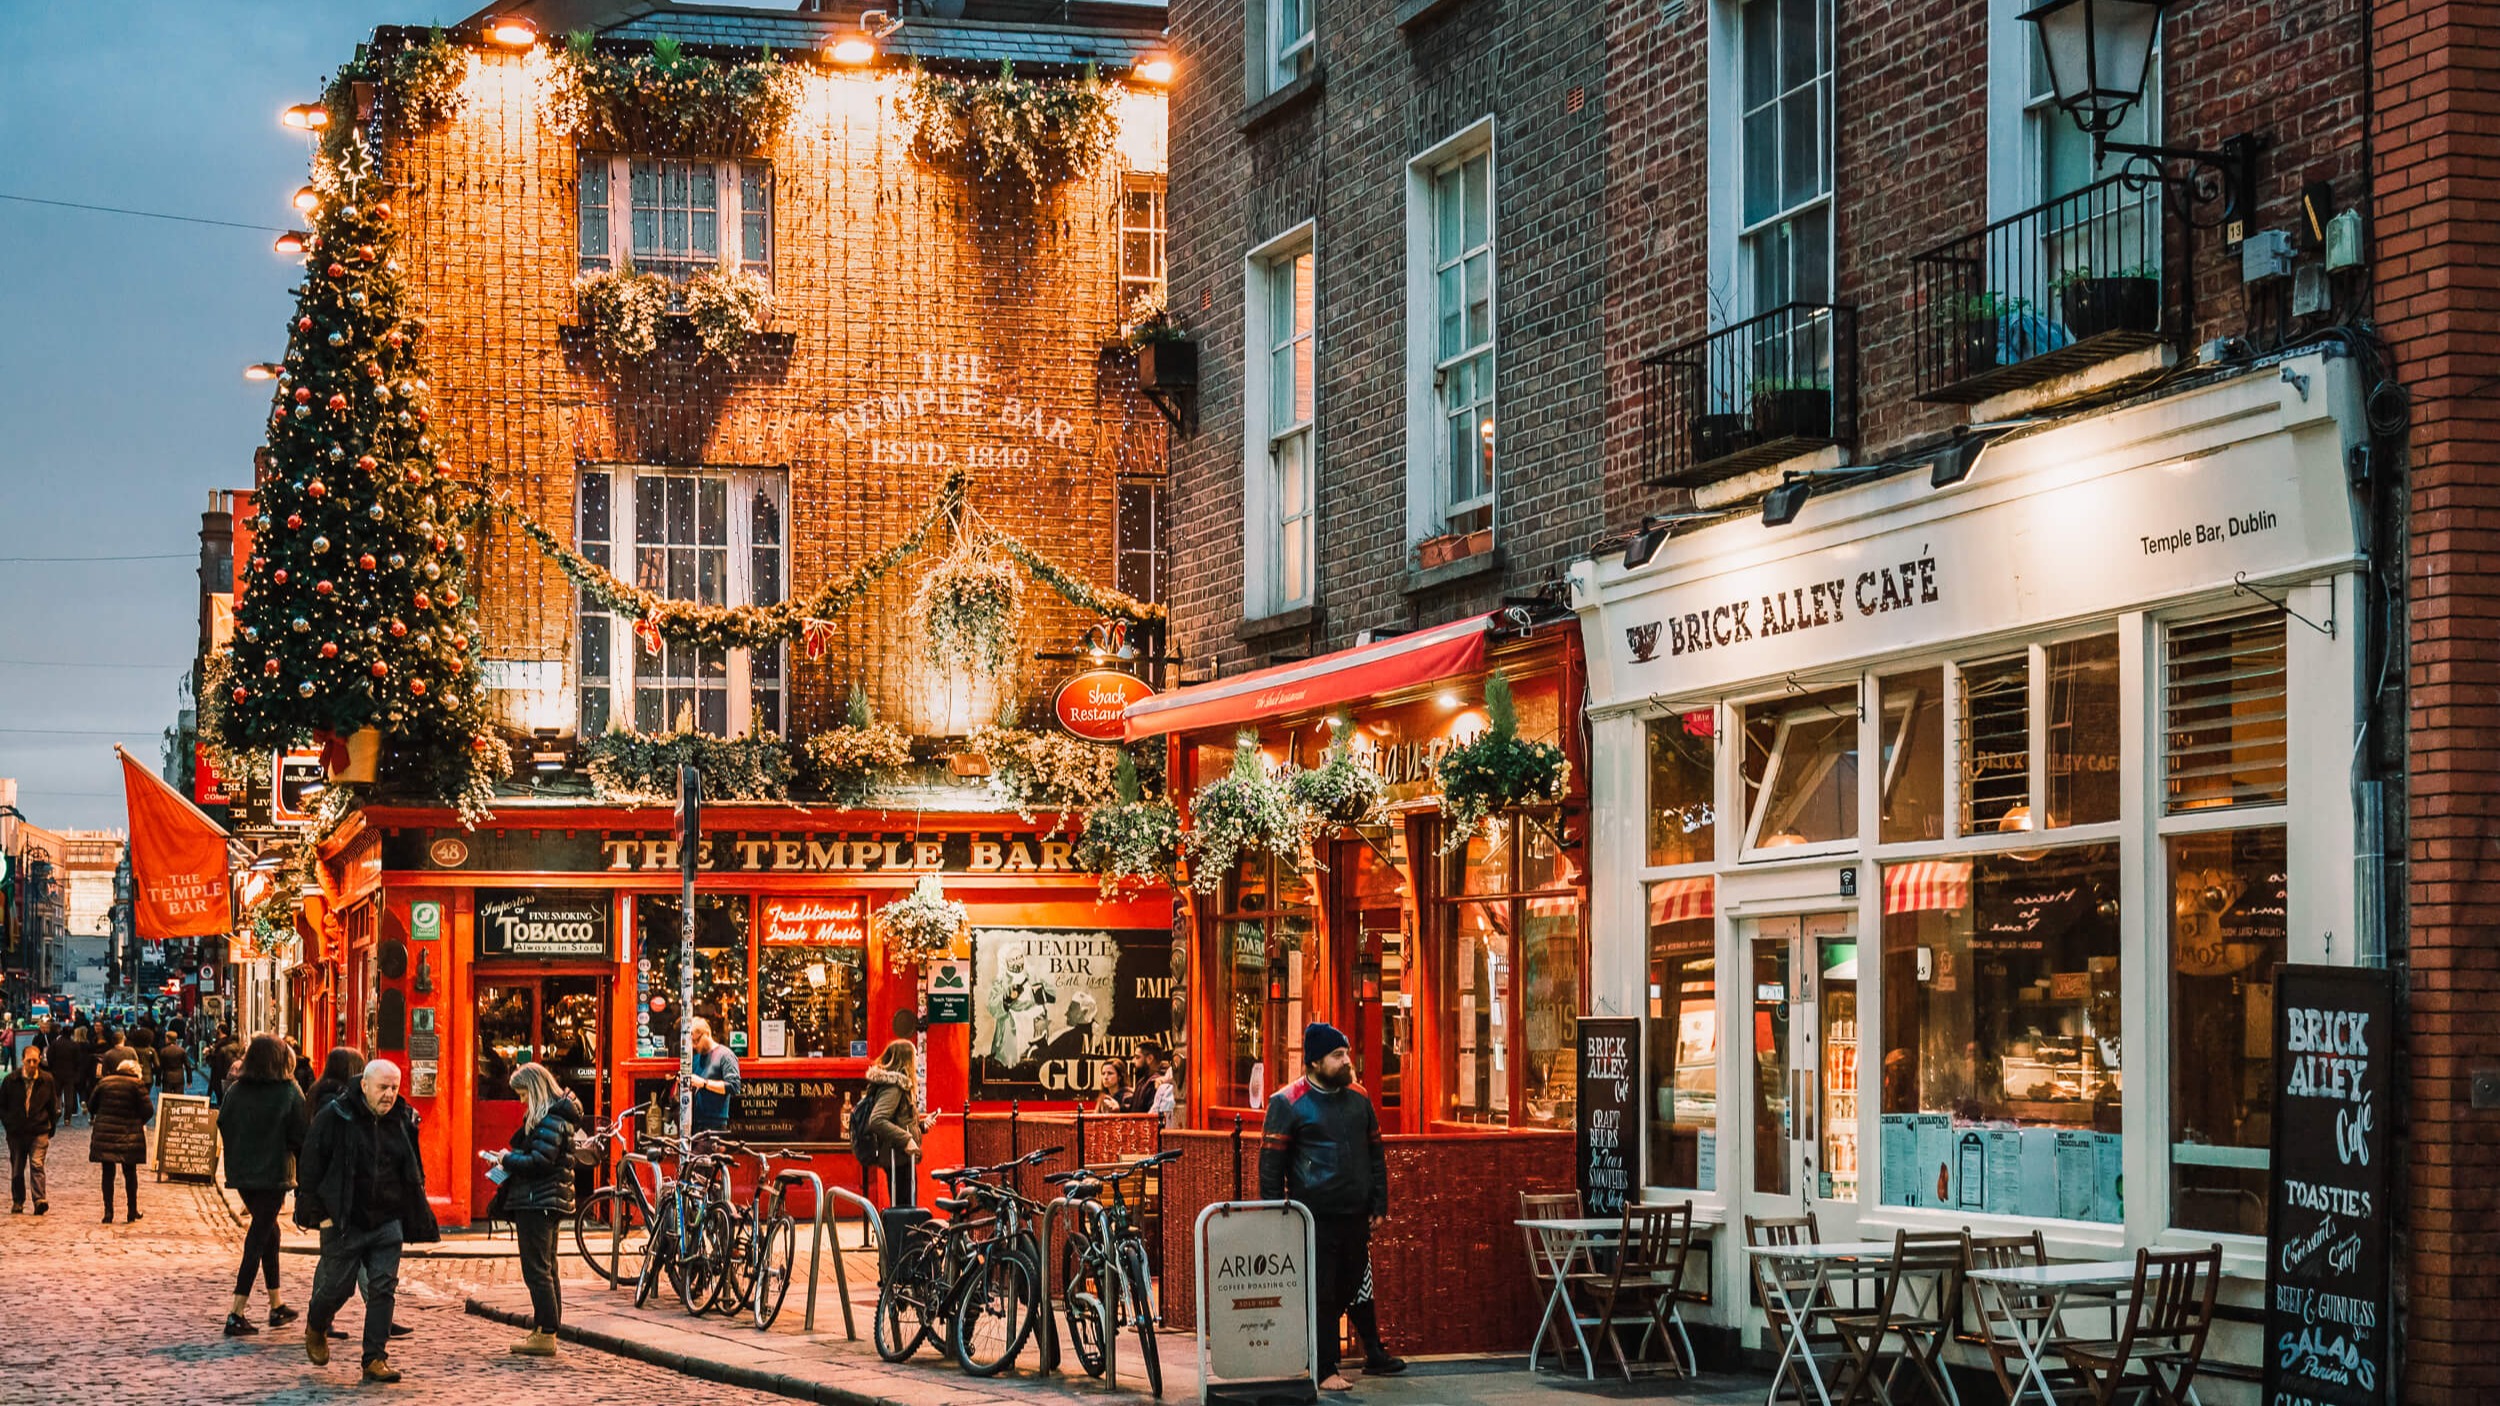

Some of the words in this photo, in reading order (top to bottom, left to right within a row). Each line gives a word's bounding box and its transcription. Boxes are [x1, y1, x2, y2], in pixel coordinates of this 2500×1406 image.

[916, 353, 989, 382] THE
[828, 387, 984, 439] TEMPLE
[1002, 397, 1075, 448] BAR
[967, 445, 1030, 468] 1840
[2140, 528, 2192, 555] Temple
[2195, 524, 2225, 543] Bar,
[2228, 510, 2277, 537] Dublin
[1669, 601, 1752, 656] BRICK
[1761, 578, 1845, 638] ALLEY
[1855, 543, 1939, 616] CAFÉ
[437, 843, 460, 860] 48
[604, 840, 715, 870] THE
[736, 839, 945, 870] TEMPLE
[969, 841, 1074, 870] BAR
[169, 873, 201, 886] THE
[147, 882, 224, 902] TEMPLE
[169, 899, 208, 915] BAR
[529, 912, 550, 920] FINE
[551, 912, 592, 920] SMOKING
[769, 903, 859, 922] Traditional
[495, 916, 594, 949] TOBACCO
[765, 923, 808, 941] Irish
[815, 923, 863, 941] Music
[515, 943, 552, 952] Always
[557, 943, 567, 951] in
[571, 943, 601, 951] Stock
[1021, 940, 1114, 956] TEMPLE
[1050, 958, 1092, 976] BAR
[2287, 1008, 2369, 1056] BRICK
[1587, 1037, 1627, 1058] BRICK
[1587, 1058, 1629, 1080] ALLEY
[2287, 1056, 2368, 1102] ALLEY
[800, 1082, 837, 1098] BAR
[1614, 1075, 1630, 1103] Café
[741, 1099, 778, 1108] DUBLIN
[1593, 1109, 1621, 1129] CRAFT
[2336, 1089, 2374, 1166] Café
[1589, 1128, 1619, 1148] BEERS
[1588, 1167, 1628, 1189] SMOOTHIES
[2284, 1180, 2372, 1219] TOASTIES
[2282, 1213, 2337, 1273] Croissants
[2328, 1237, 2361, 1276] Soup
[1248, 1281, 1284, 1290] ROASTING
[1286, 1280, 1297, 1288] CO
[2276, 1283, 2303, 1314] BEEF
[2303, 1288, 2316, 1325] &
[2318, 1292, 2376, 1328] GUINNESS
[2278, 1326, 2376, 1392] SALADS
[2299, 1354, 2349, 1386] Paninis
